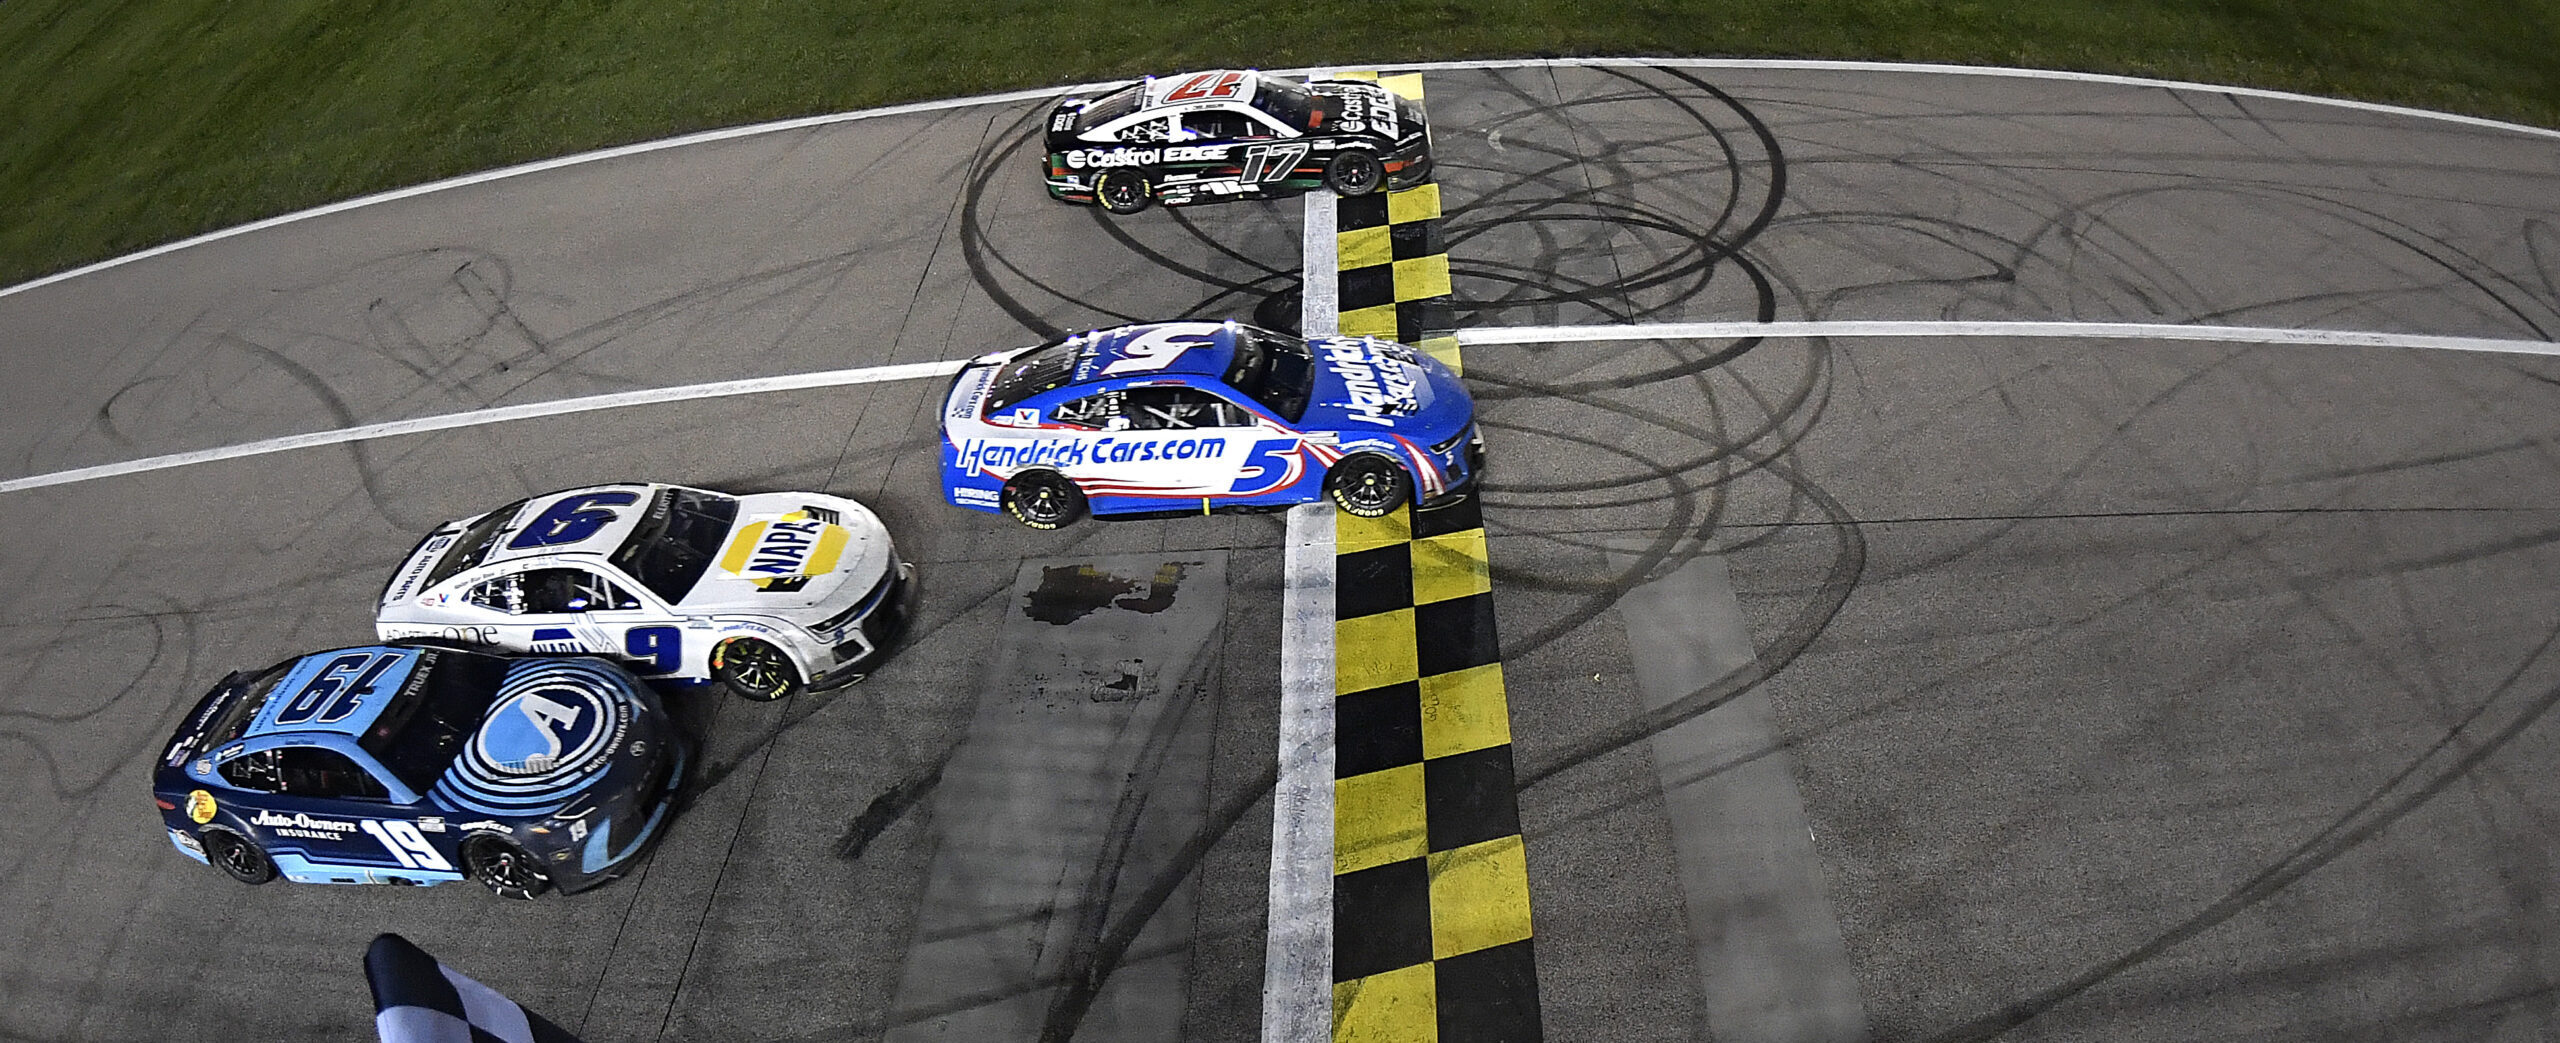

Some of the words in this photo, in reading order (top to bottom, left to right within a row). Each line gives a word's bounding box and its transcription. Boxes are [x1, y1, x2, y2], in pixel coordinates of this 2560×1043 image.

[1087, 147, 1161, 168] Castrol
[1163, 147, 1229, 162] EDGE
[1240, 143, 1310, 184] 17
[1100, 322, 1224, 375] 5
[1229, 439, 1299, 492] 5
[507, 491, 641, 550] 9
[749, 521, 823, 573] NAPA
[625, 624, 682, 676] 9
[274, 653, 406, 725] 19
[404, 663, 434, 697] TRUEX
[250, 810, 359, 833] Auto-Owners
[276, 828, 343, 841] INSURANCE
[360, 819, 453, 870] 19
